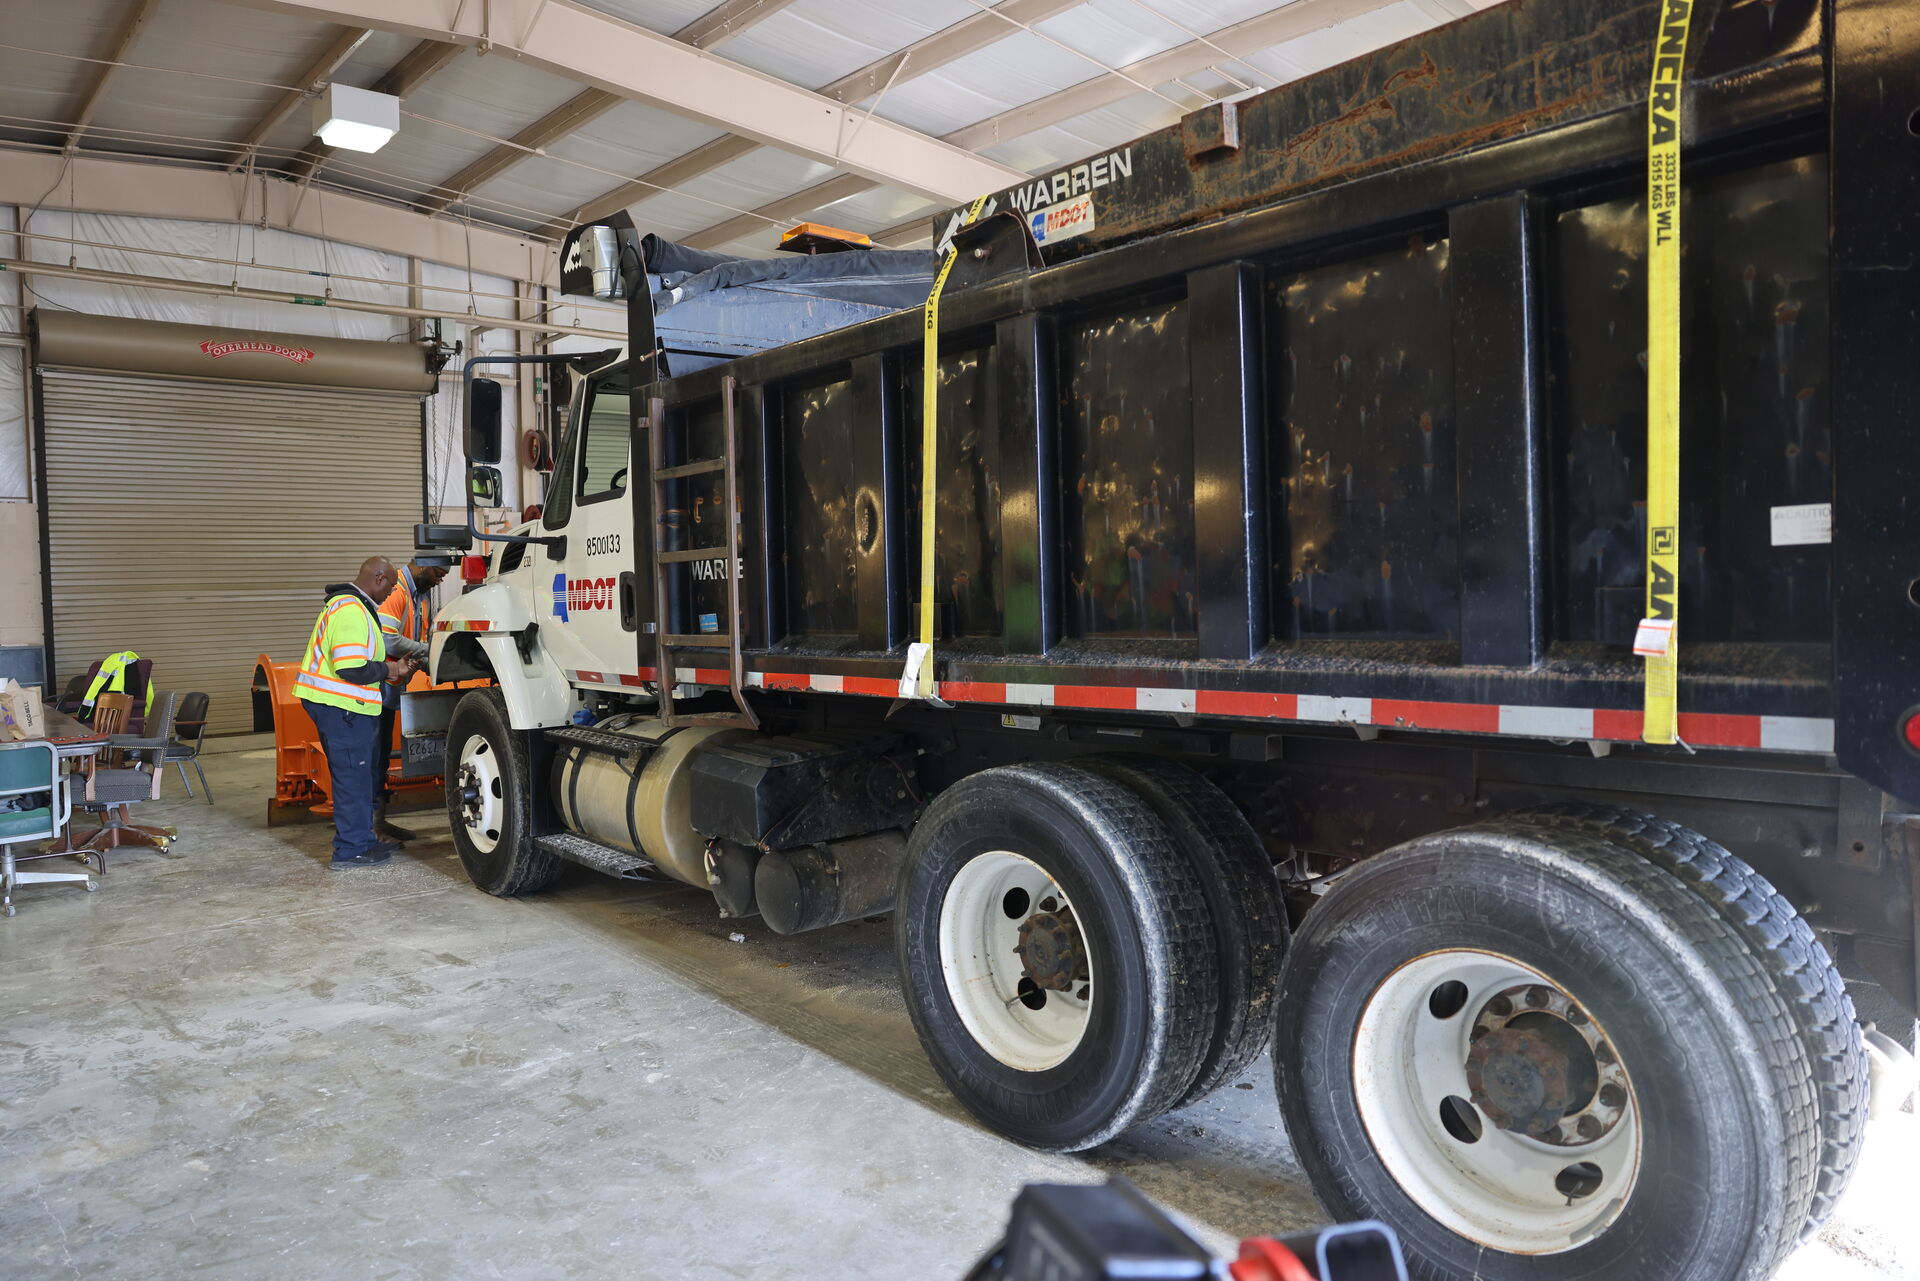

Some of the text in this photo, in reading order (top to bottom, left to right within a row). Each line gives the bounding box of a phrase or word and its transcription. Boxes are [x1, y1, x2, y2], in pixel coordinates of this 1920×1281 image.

[1653, 0, 1689, 146] ANCRA
[1009, 147, 1133, 213] WARREN
[1652, 153, 1663, 210] 1515 KGS
[1665, 152, 1677, 208] 3333 LBS
[1046, 200, 1090, 233] MDOT
[1657, 210, 1672, 246] WLL
[927, 310, 934, 330] KG
[213, 342, 303, 361] OVERHEAD DOOR
[586, 534, 621, 557] 8500133
[568, 577, 616, 611] MDOT
[25, 713, 33, 727] TACO
